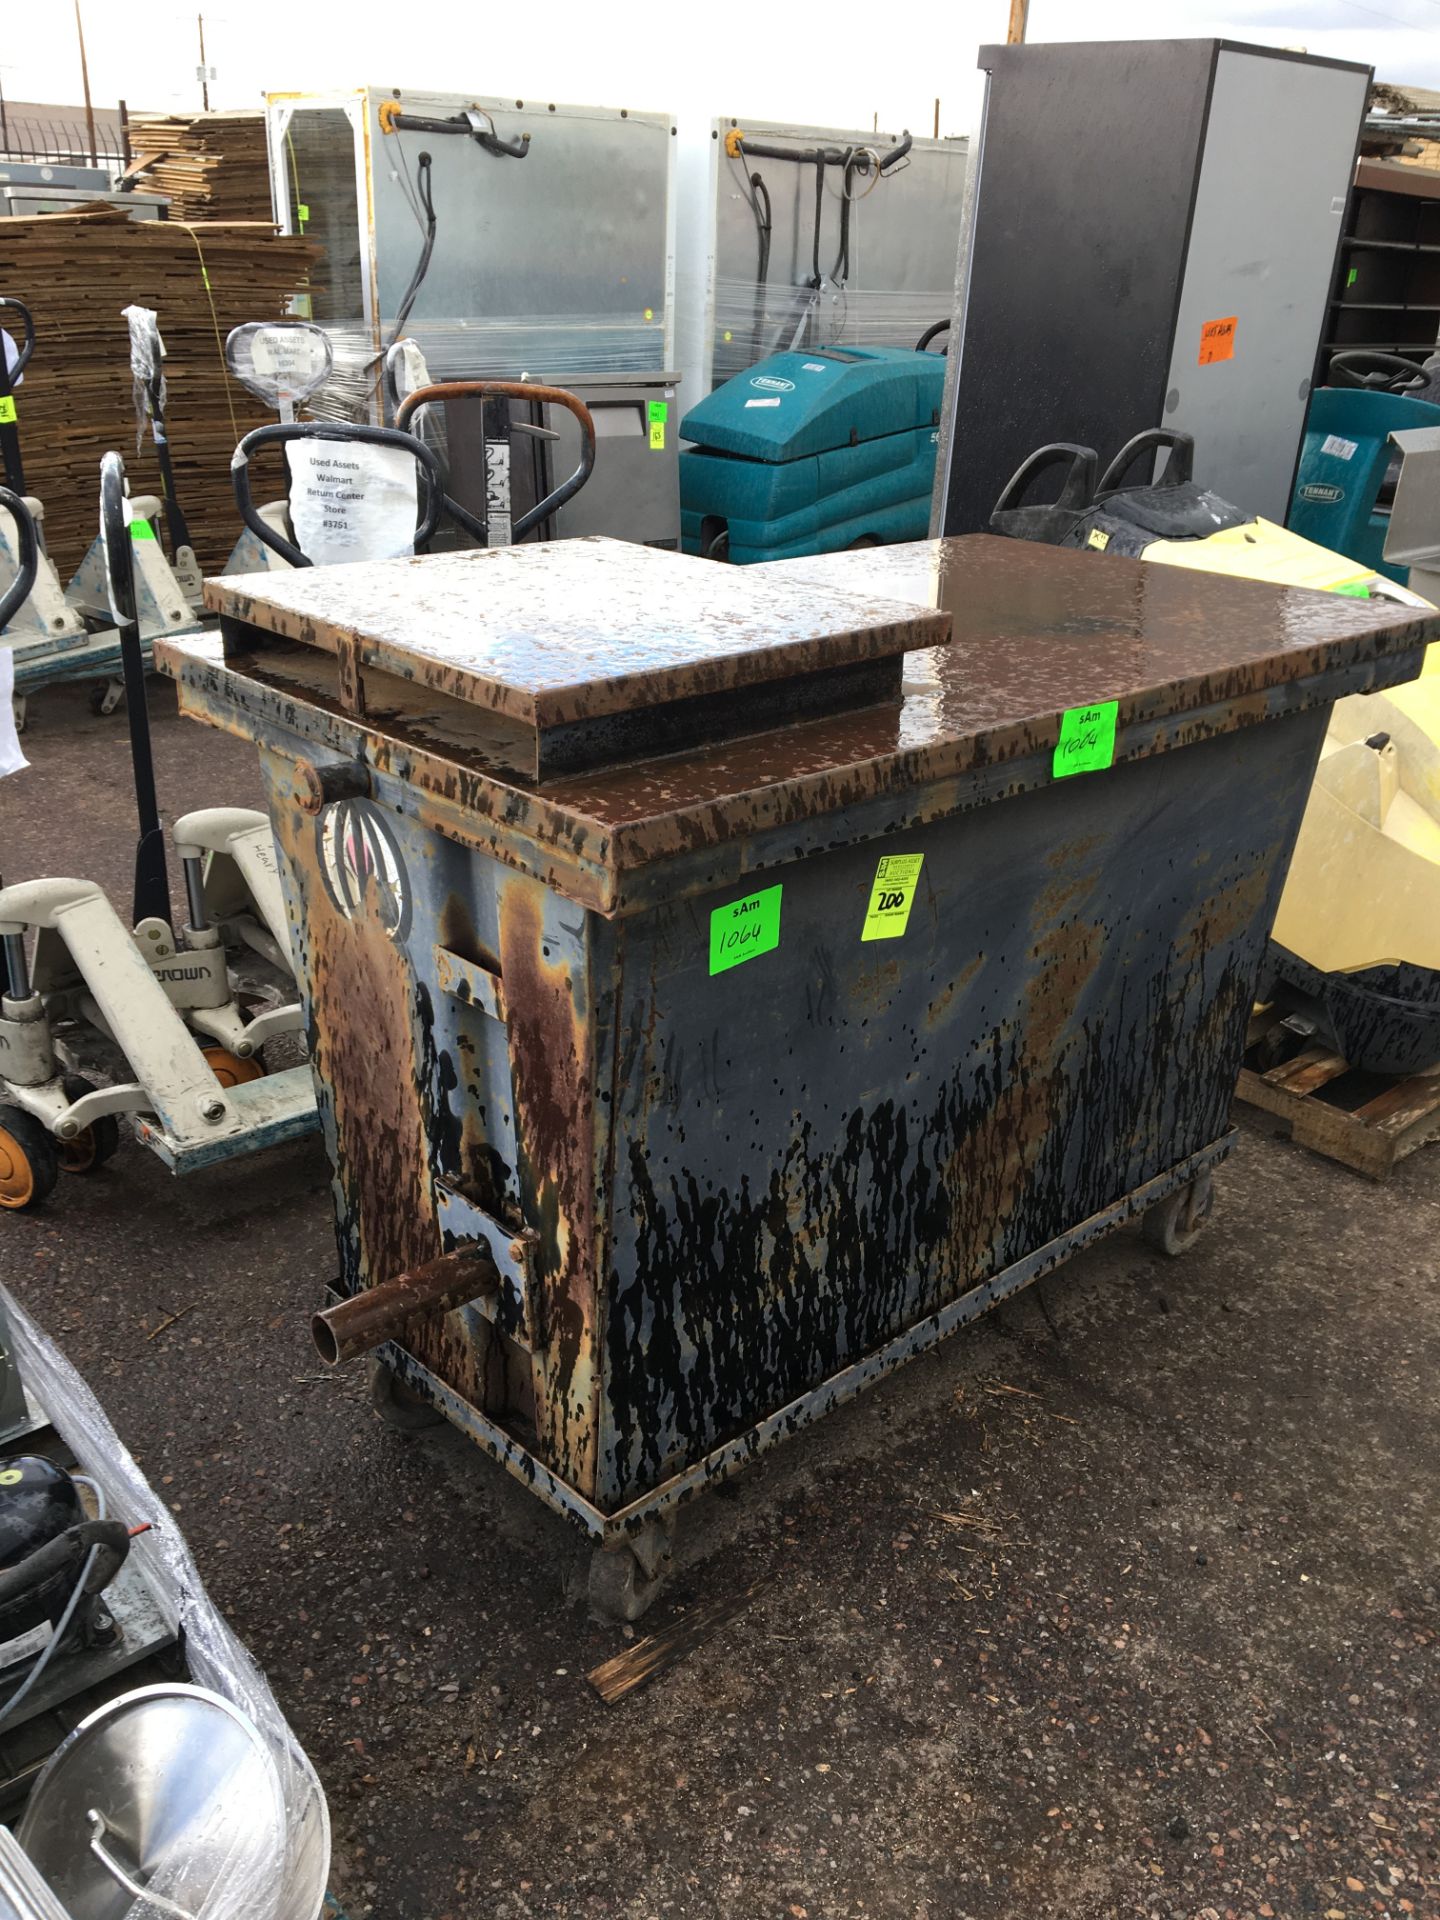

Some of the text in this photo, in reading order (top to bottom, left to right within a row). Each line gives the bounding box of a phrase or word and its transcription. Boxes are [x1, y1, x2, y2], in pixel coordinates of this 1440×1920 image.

[310, 458, 360, 470] Used Assets
[316, 473, 353, 485] Walmart
[307, 488, 365, 500] Return Center
[324, 504, 347, 514] Store
[322, 520, 348, 529] #3751
[1063, 728, 1098, 759] 1064
[878, 891, 905, 911] 200
[720, 923, 761, 954] 1064
